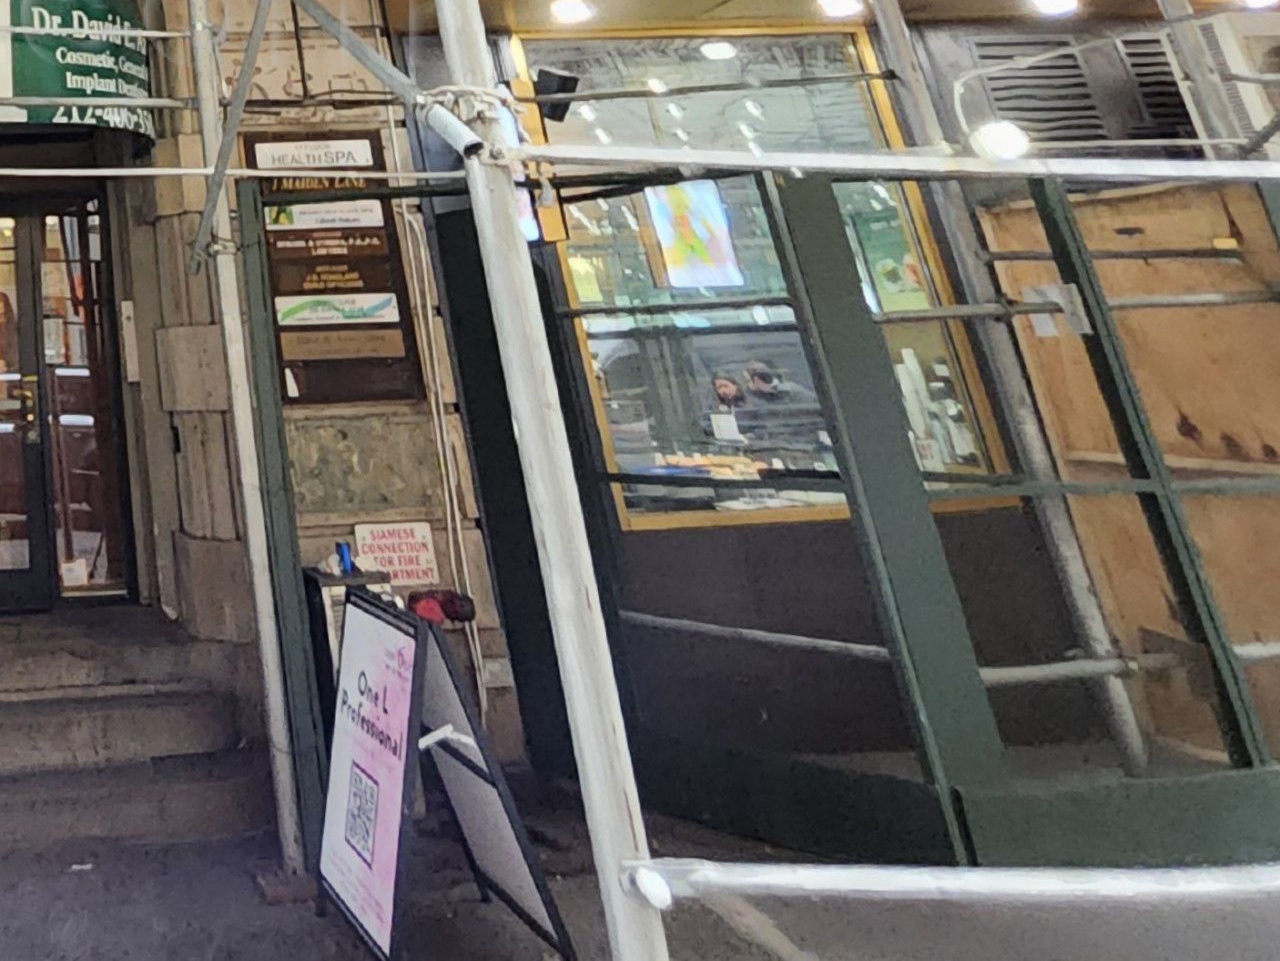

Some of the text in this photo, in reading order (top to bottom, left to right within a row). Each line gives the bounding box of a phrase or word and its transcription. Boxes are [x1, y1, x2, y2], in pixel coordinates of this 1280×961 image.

[31, 6, 68, 37] Dr.
[72, 9, 121, 45] David
[55, 46, 118, 72] Cosmetic,
[65, 71, 117, 95] Implant
[323, 150, 357, 165] SPA
[369, 528, 416, 541] SIAMESE
[361, 541, 430, 555] CONNECTION
[358, 669, 380, 708] One
[340, 688, 404, 763] Professional
